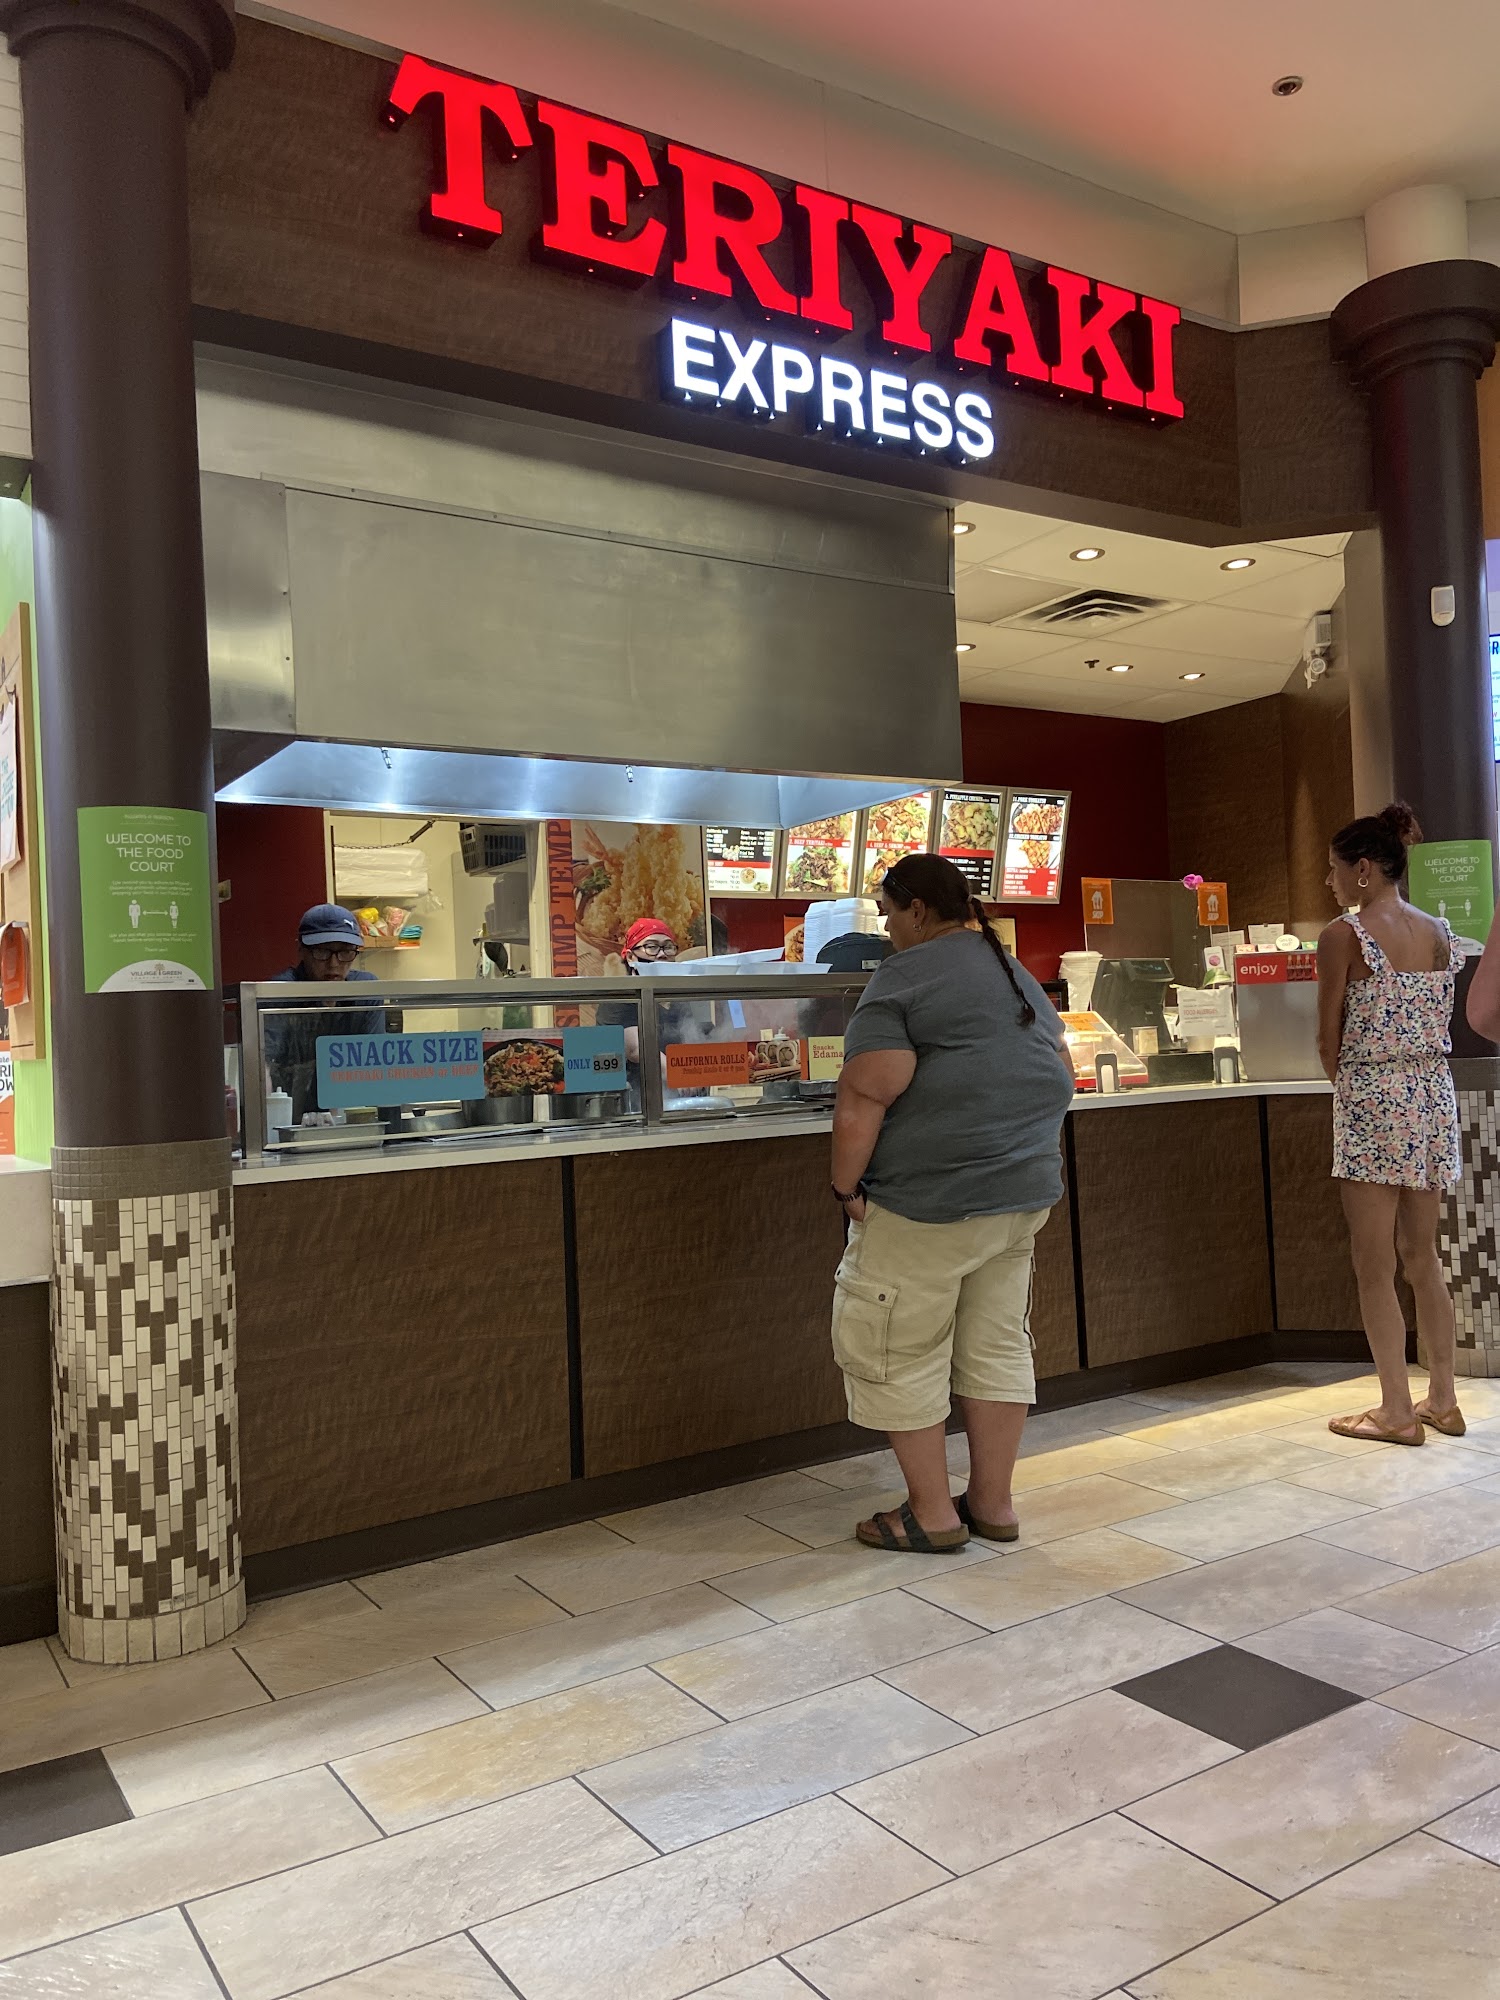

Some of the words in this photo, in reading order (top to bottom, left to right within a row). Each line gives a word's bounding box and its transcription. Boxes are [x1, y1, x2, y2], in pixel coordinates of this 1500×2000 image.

[389, 54, 1185, 419] TERIYAKI
[670, 316, 996, 459] EXPRESS
[105, 833, 174, 845] WELCOME
[175, 835, 192, 846] TO
[116, 847, 143, 858] THE
[146, 847, 184, 859] FOOD
[129, 861, 175, 872] COURT
[1424, 857, 1468, 867] WELCOME
[1470, 856, 1480, 864] TO
[1430, 867, 1448, 875] THE
[1449, 865, 1475, 874] FOOD
[1438, 874, 1469, 883] COURT
[1240, 963, 1278, 976] enjoy
[328, 1040, 415, 1069] SNACK
[422, 1037, 479, 1064] SIZE
[567, 1058, 591, 1071] ONLY
[593, 1058, 619, 1071] 8.99
[670, 1055, 720, 1068] CALIFORNIA
[720, 1054, 746, 1065] ROLLS
